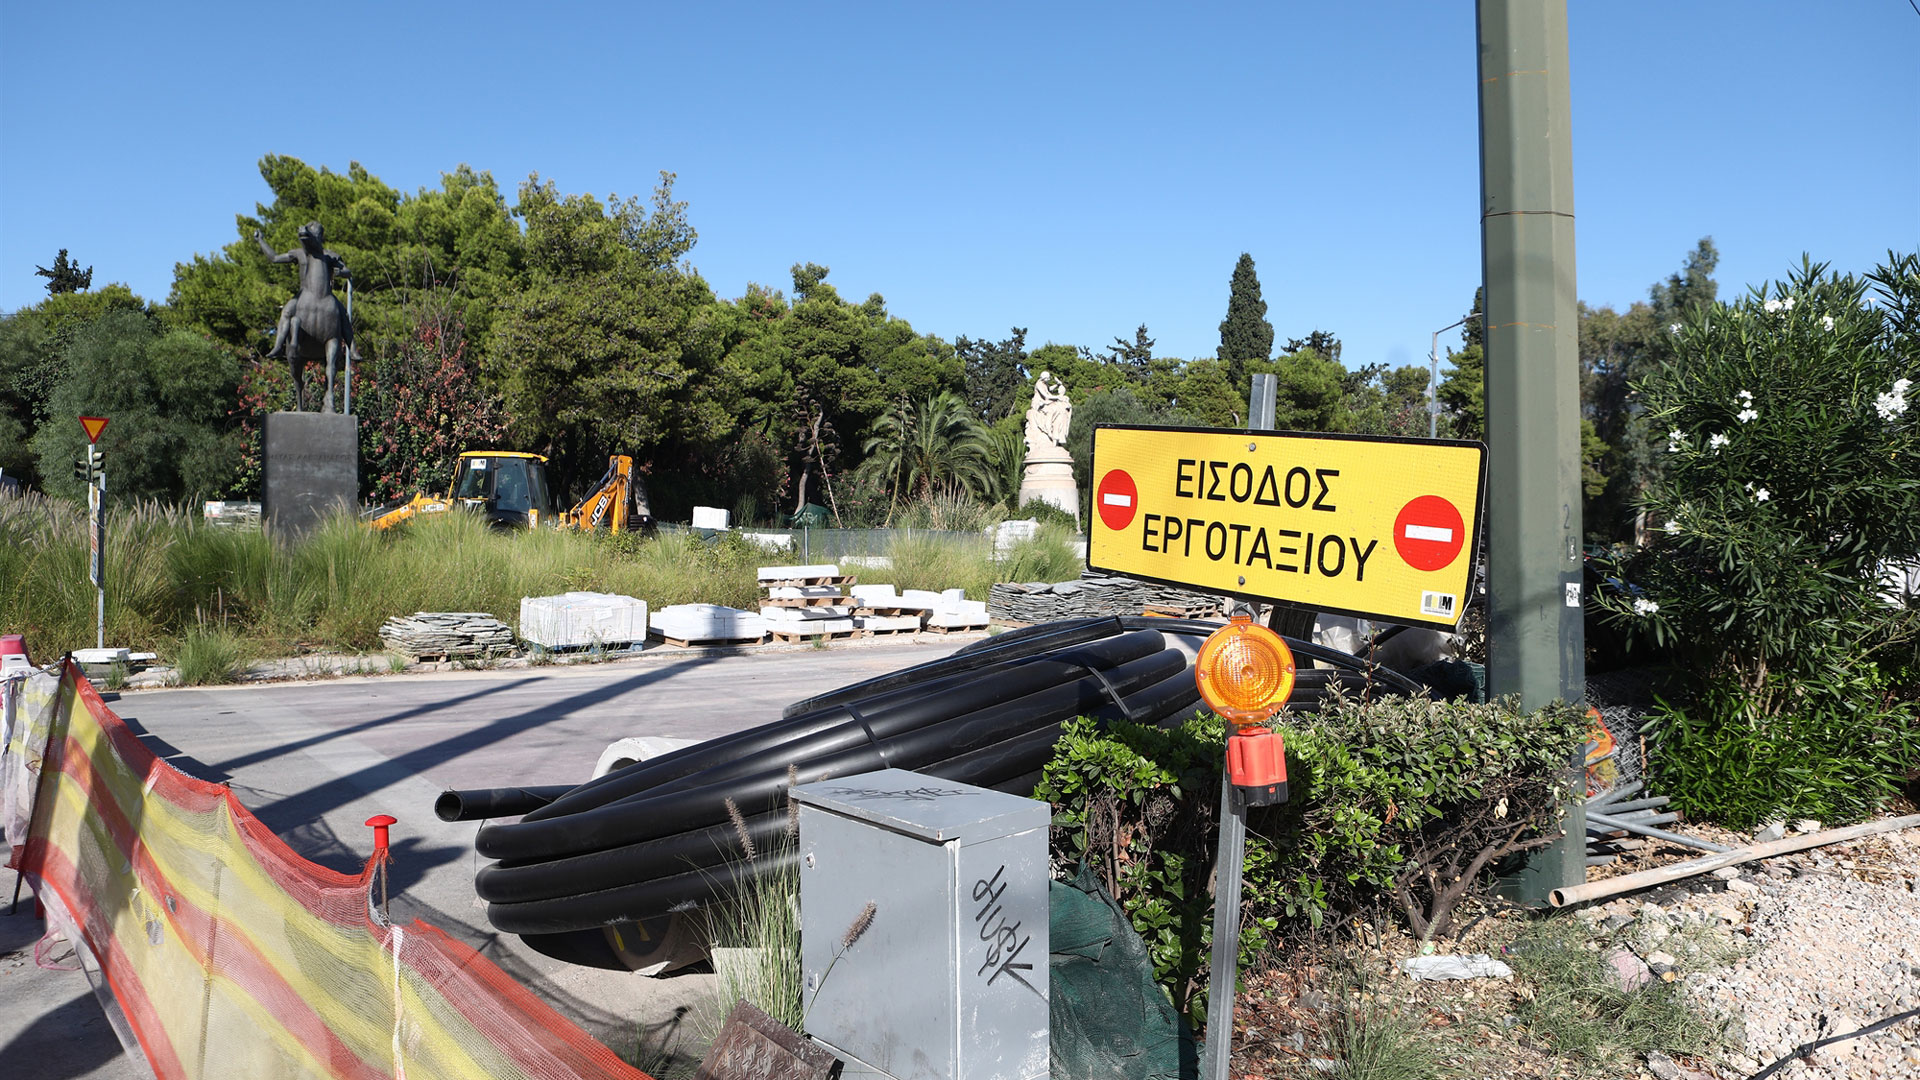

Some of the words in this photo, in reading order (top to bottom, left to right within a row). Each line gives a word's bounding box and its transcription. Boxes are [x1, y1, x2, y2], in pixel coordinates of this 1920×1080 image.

[1175, 458, 1340, 513] ΕΙΣΟΔΟΣ
[421, 504, 444, 513] JCB
[591, 495, 608, 526] JCB
[1142, 513, 1379, 582] ΕΡΓΟΤΑΞΙΟΥ
